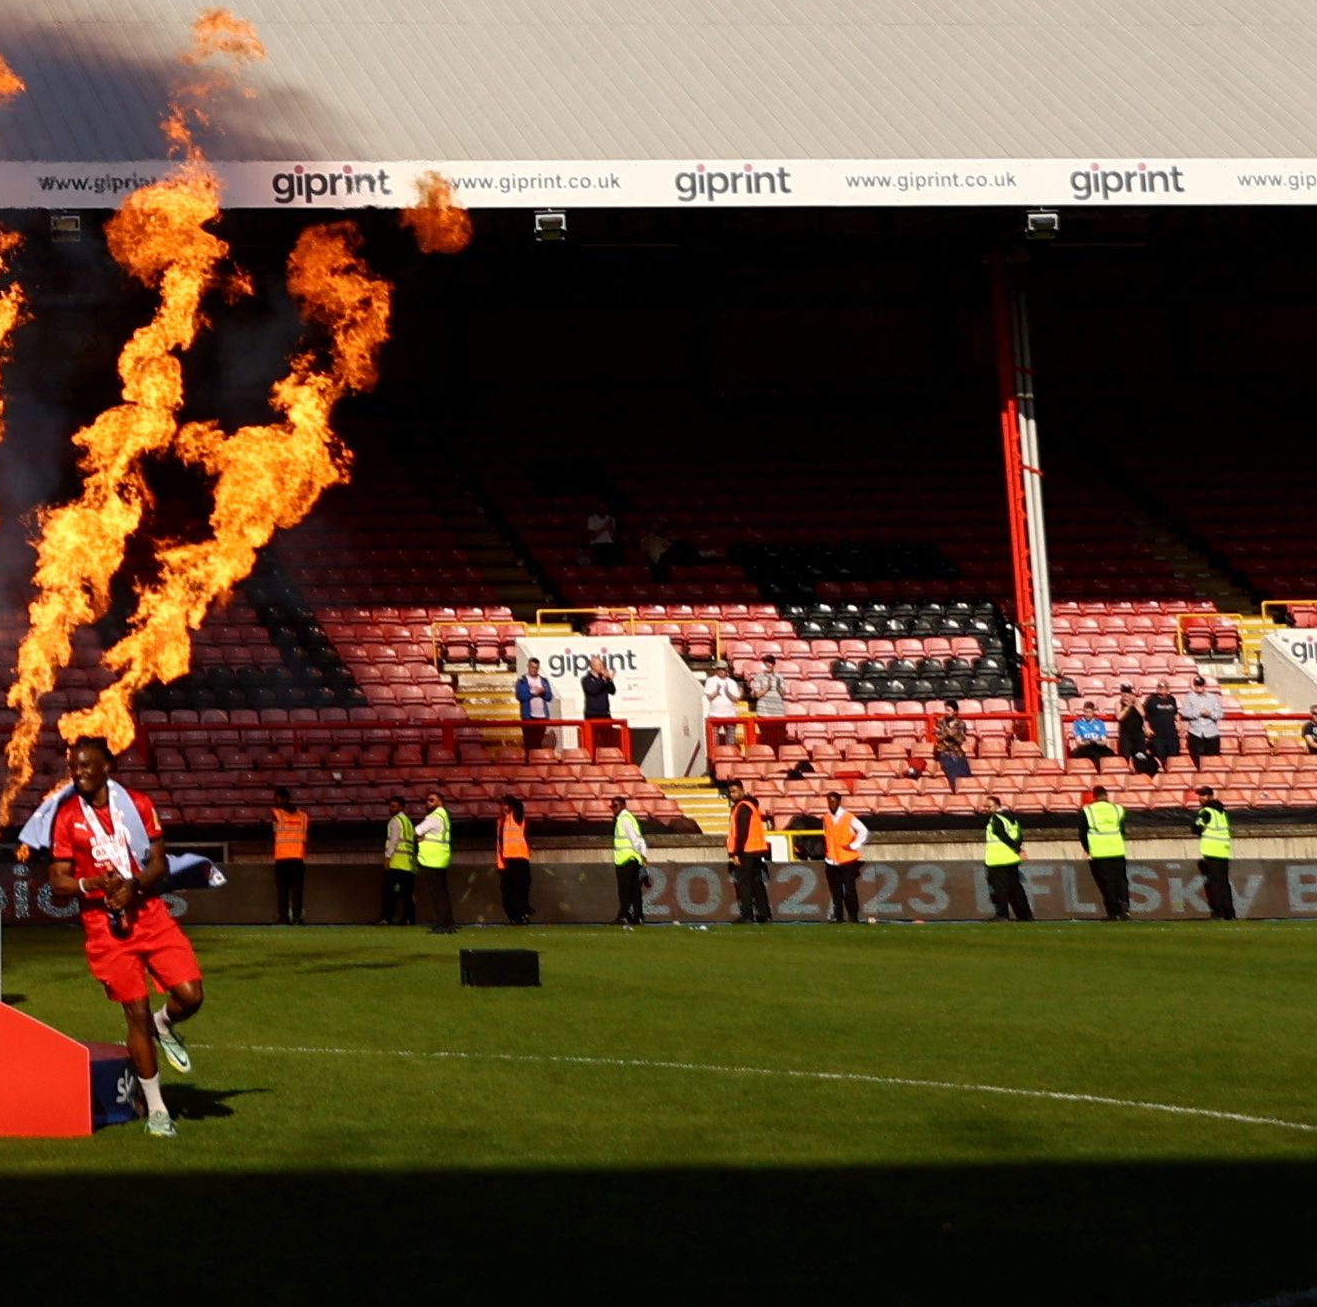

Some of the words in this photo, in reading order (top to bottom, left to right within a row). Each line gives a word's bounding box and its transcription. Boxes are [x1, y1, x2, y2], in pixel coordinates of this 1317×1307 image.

[272, 164, 391, 204] giprint
[675, 163, 792, 202] giprint
[844, 171, 1018, 191] www.giprint.co.uk
[1070, 162, 1186, 201] giprint
